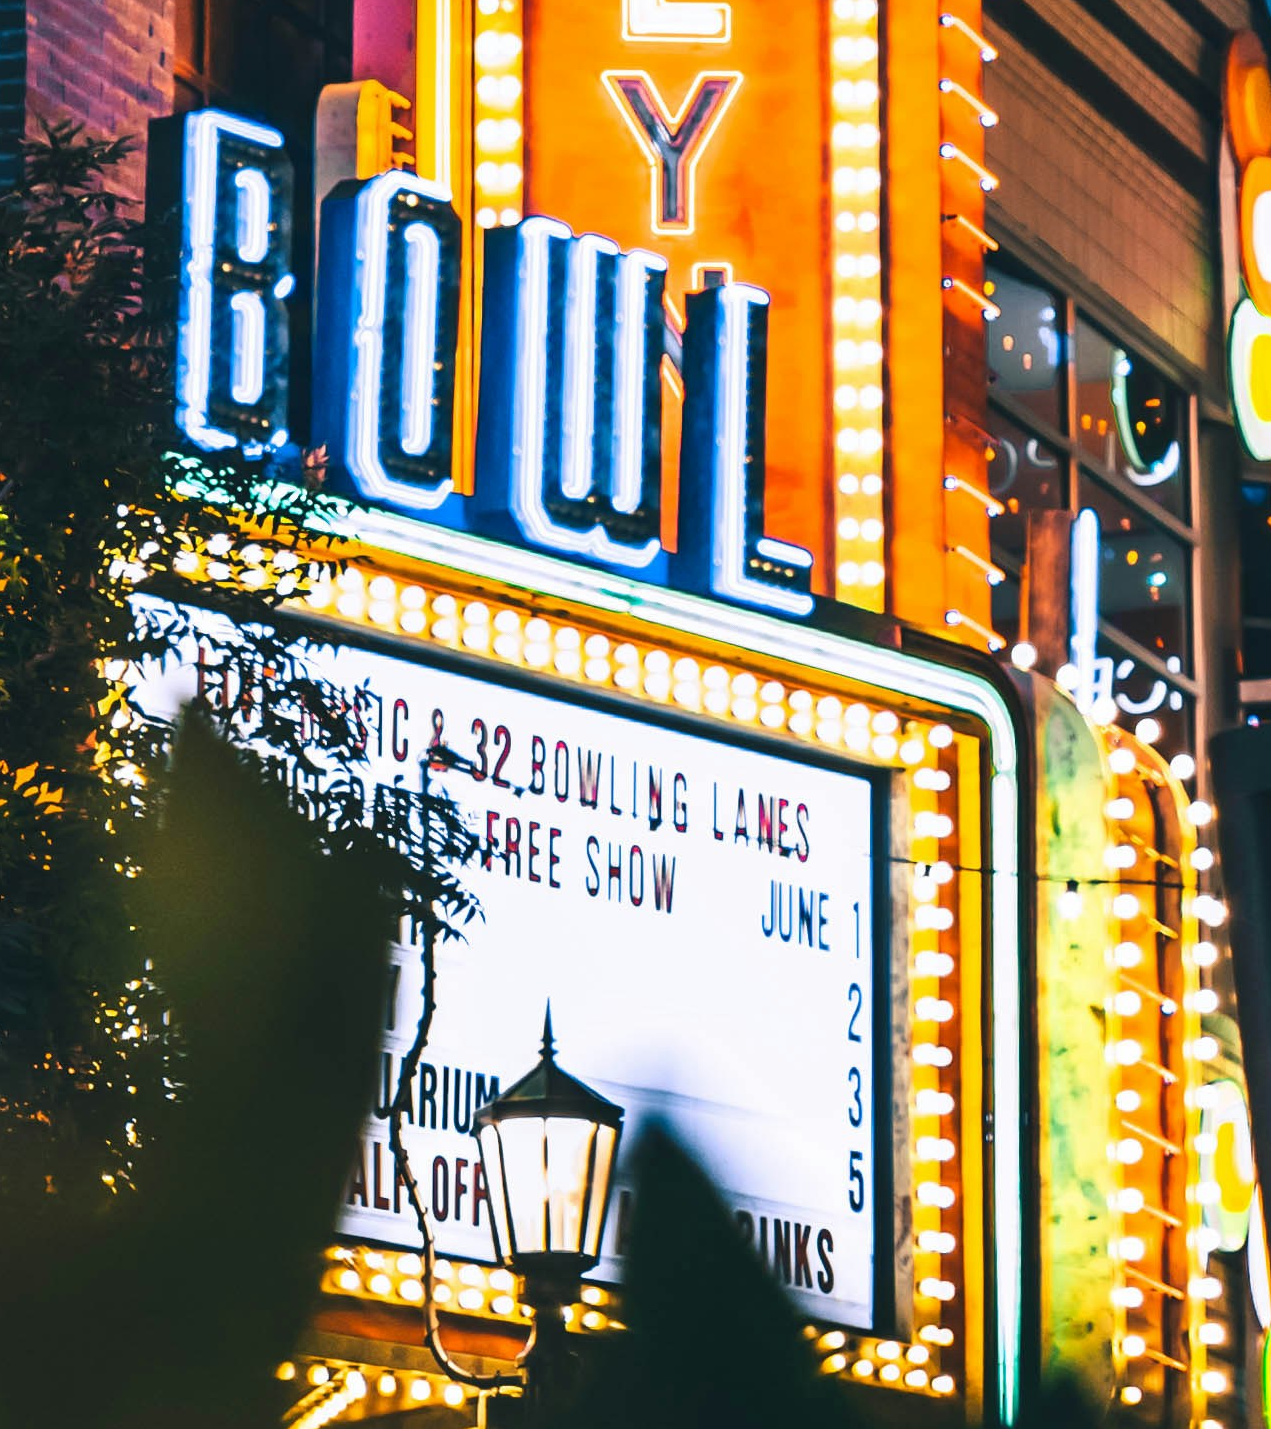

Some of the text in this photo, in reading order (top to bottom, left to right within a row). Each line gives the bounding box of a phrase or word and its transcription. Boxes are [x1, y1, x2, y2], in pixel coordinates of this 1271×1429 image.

[172, 108, 815, 618] BOWL
[471, 717, 512, 788] 32
[530, 734, 688, 834] BOWLING
[713, 781, 810, 863] LANES
[485, 810, 861, 958] FREE SHOW JUNE 1
[847, 982, 863, 1043] 2
[847, 1066, 864, 1128] 3
[847, 1151, 866, 1213] 5
